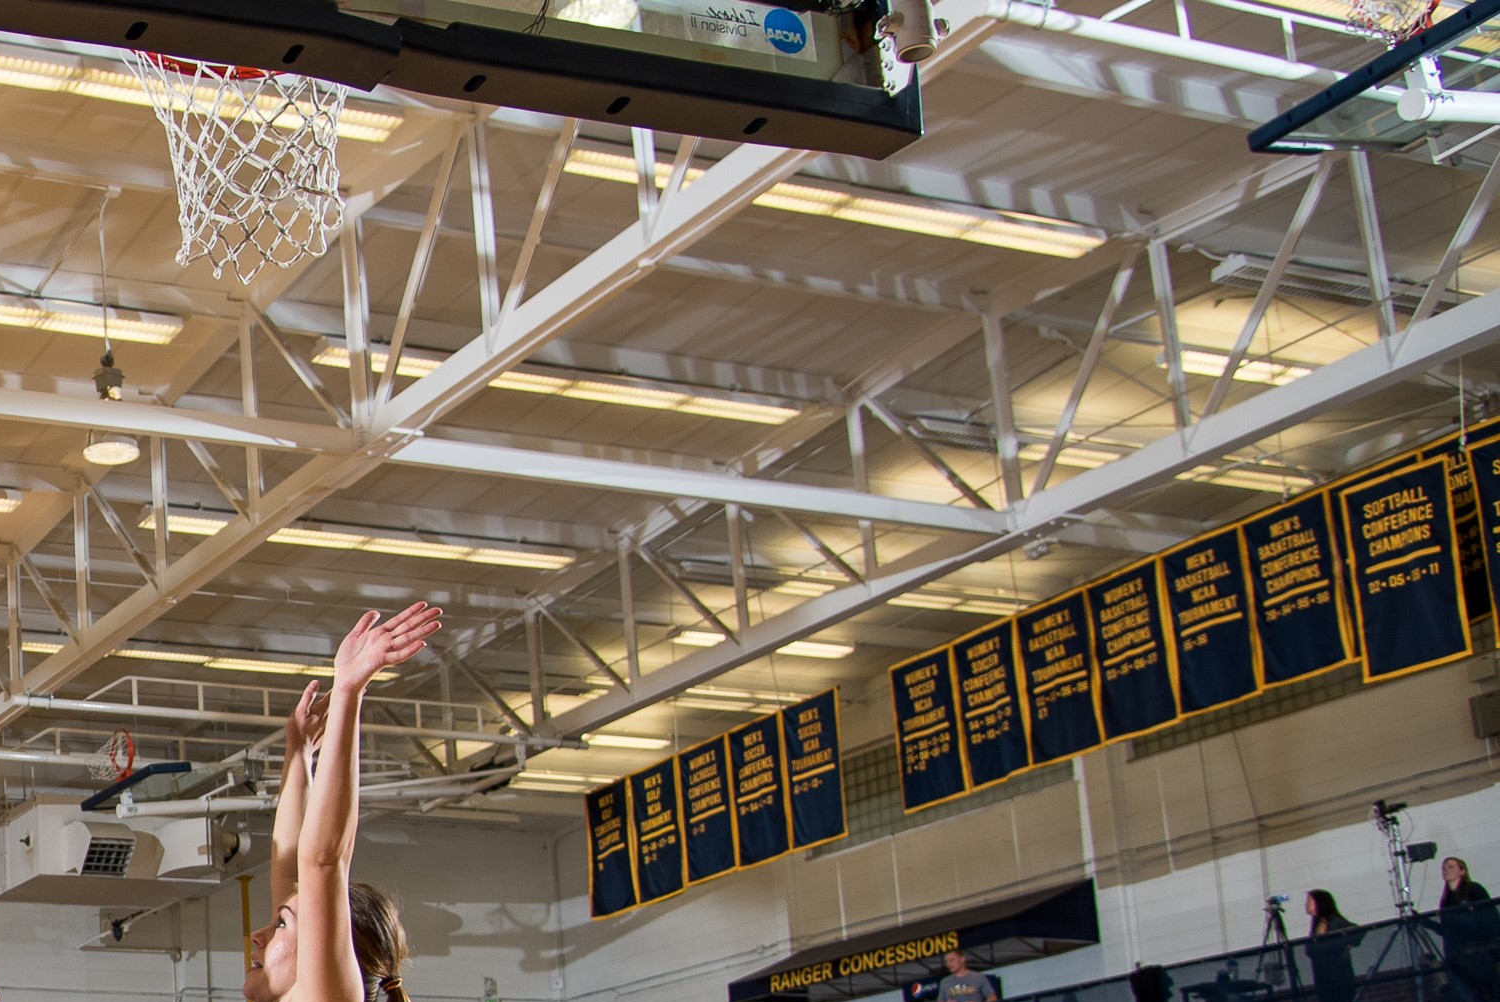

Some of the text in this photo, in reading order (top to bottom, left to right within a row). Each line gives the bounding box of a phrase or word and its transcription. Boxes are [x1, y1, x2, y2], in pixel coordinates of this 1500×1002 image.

[1362, 486, 1428, 519] SOFTBALL
[1269, 515, 1301, 538] MEN'S
[1362, 503, 1434, 540] CONFERENCE
[1258, 528, 1316, 561] BASKETBALL
[1369, 523, 1431, 557] CHAMPIONS
[1175, 561, 1231, 593] BASKETBALL
[1260, 544, 1321, 578] CONFERENCE
[1266, 563, 1321, 595] CHAMPIONS
[1100, 592, 1148, 623] BASKETBALL
[1101, 607, 1150, 639] CONFERENCE
[1178, 594, 1237, 626] TOURNAMENT
[770, 931, 959, 993] RANGER CONCESSIONS
